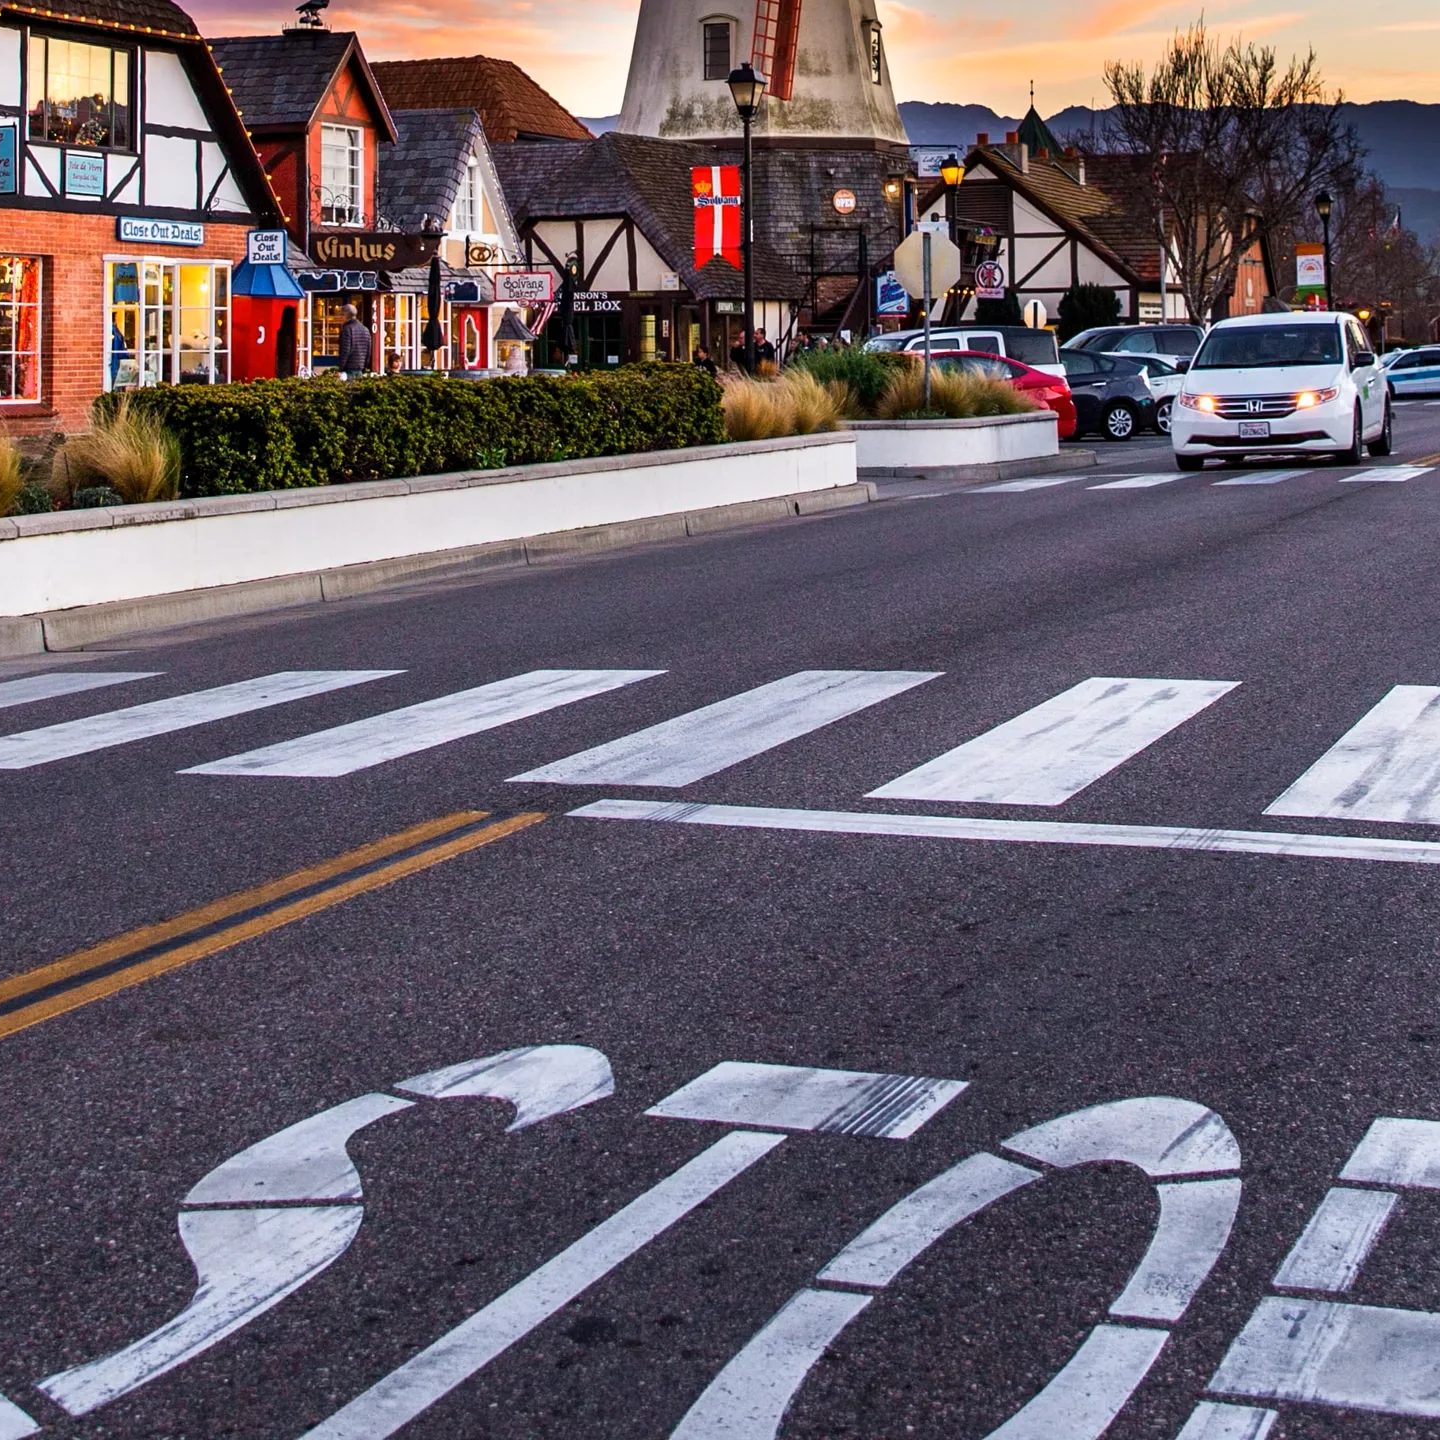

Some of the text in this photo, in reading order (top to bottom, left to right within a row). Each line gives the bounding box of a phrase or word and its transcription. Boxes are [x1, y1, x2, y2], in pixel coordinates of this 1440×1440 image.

[697, 193, 738, 208] Solvang
[123, 222, 201, 241] Close Out Deals!
[254, 233, 278, 242] Close
[257, 243, 275, 252] Out
[316, 236, 397, 262] Vinhus
[252, 252, 281, 261] Deals!
[503, 277, 544, 291] Solvang
[509, 288, 539, 299] Bakery
[573, 291, 608, 300] NSON'S
[594, 301, 622, 311] BOX
